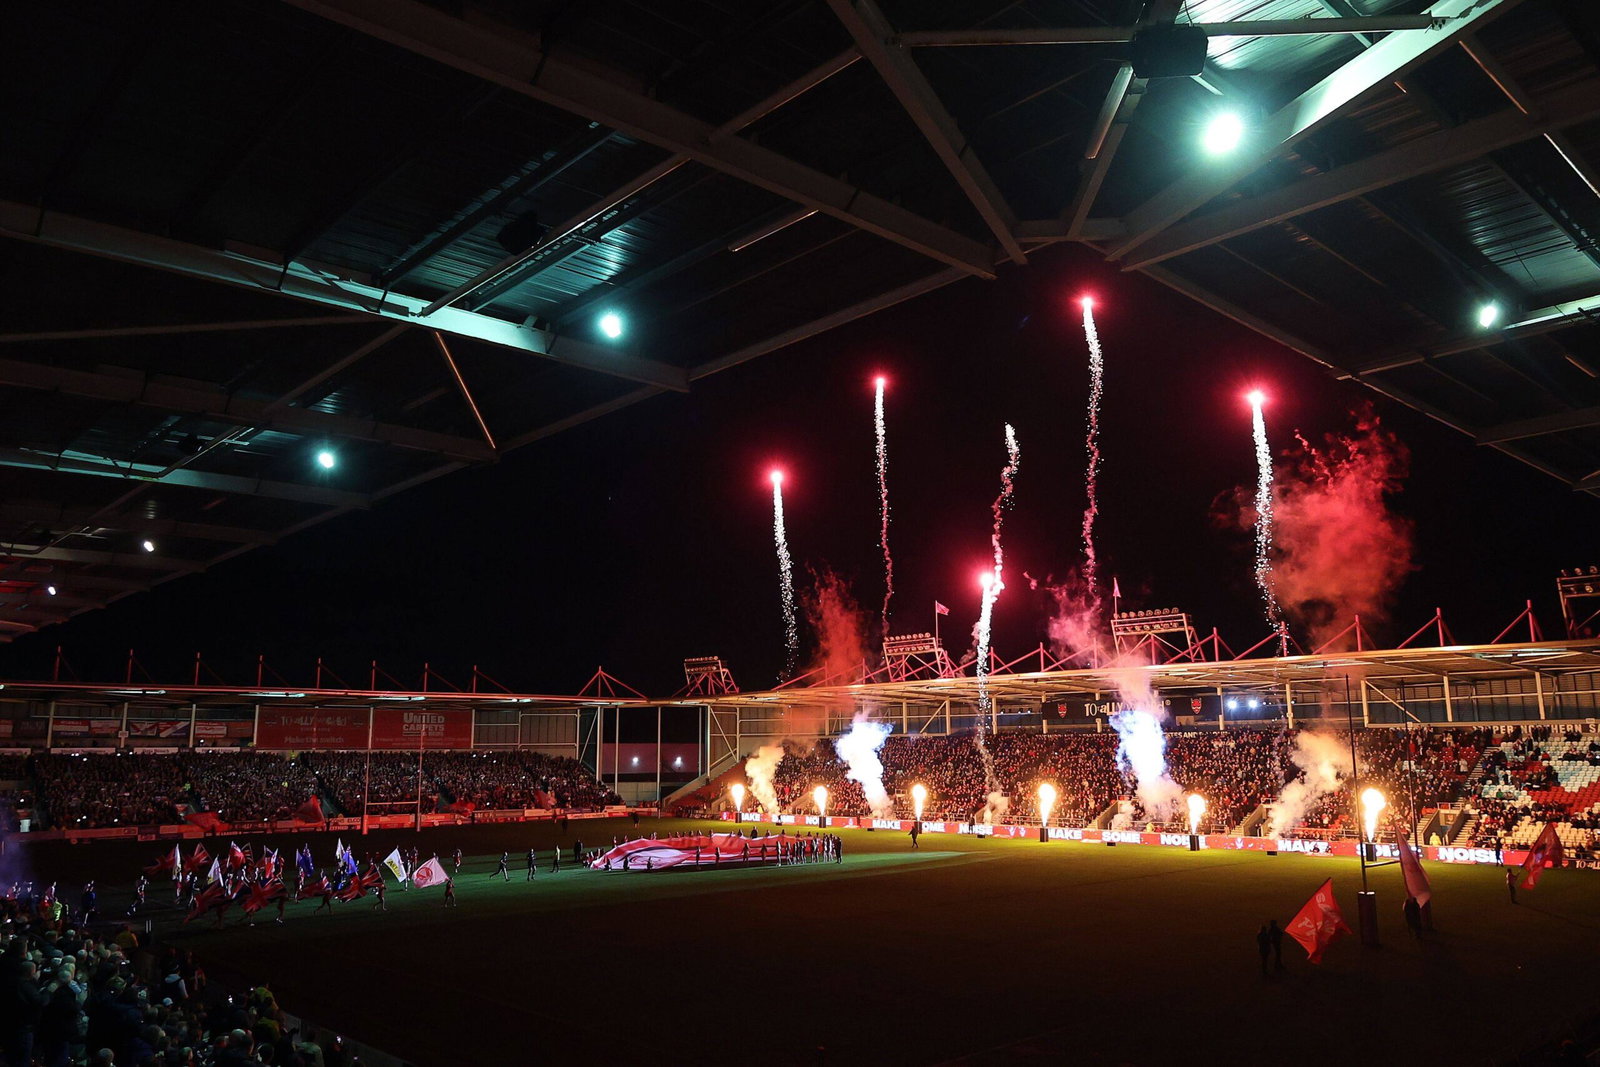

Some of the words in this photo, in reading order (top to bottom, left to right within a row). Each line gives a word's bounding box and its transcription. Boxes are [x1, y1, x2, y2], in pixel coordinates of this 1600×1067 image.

[403, 712, 445, 724] UNITED
[872, 819, 900, 830] MAKE
[921, 821, 945, 833] OME
[1101, 831, 1141, 844] SOME
